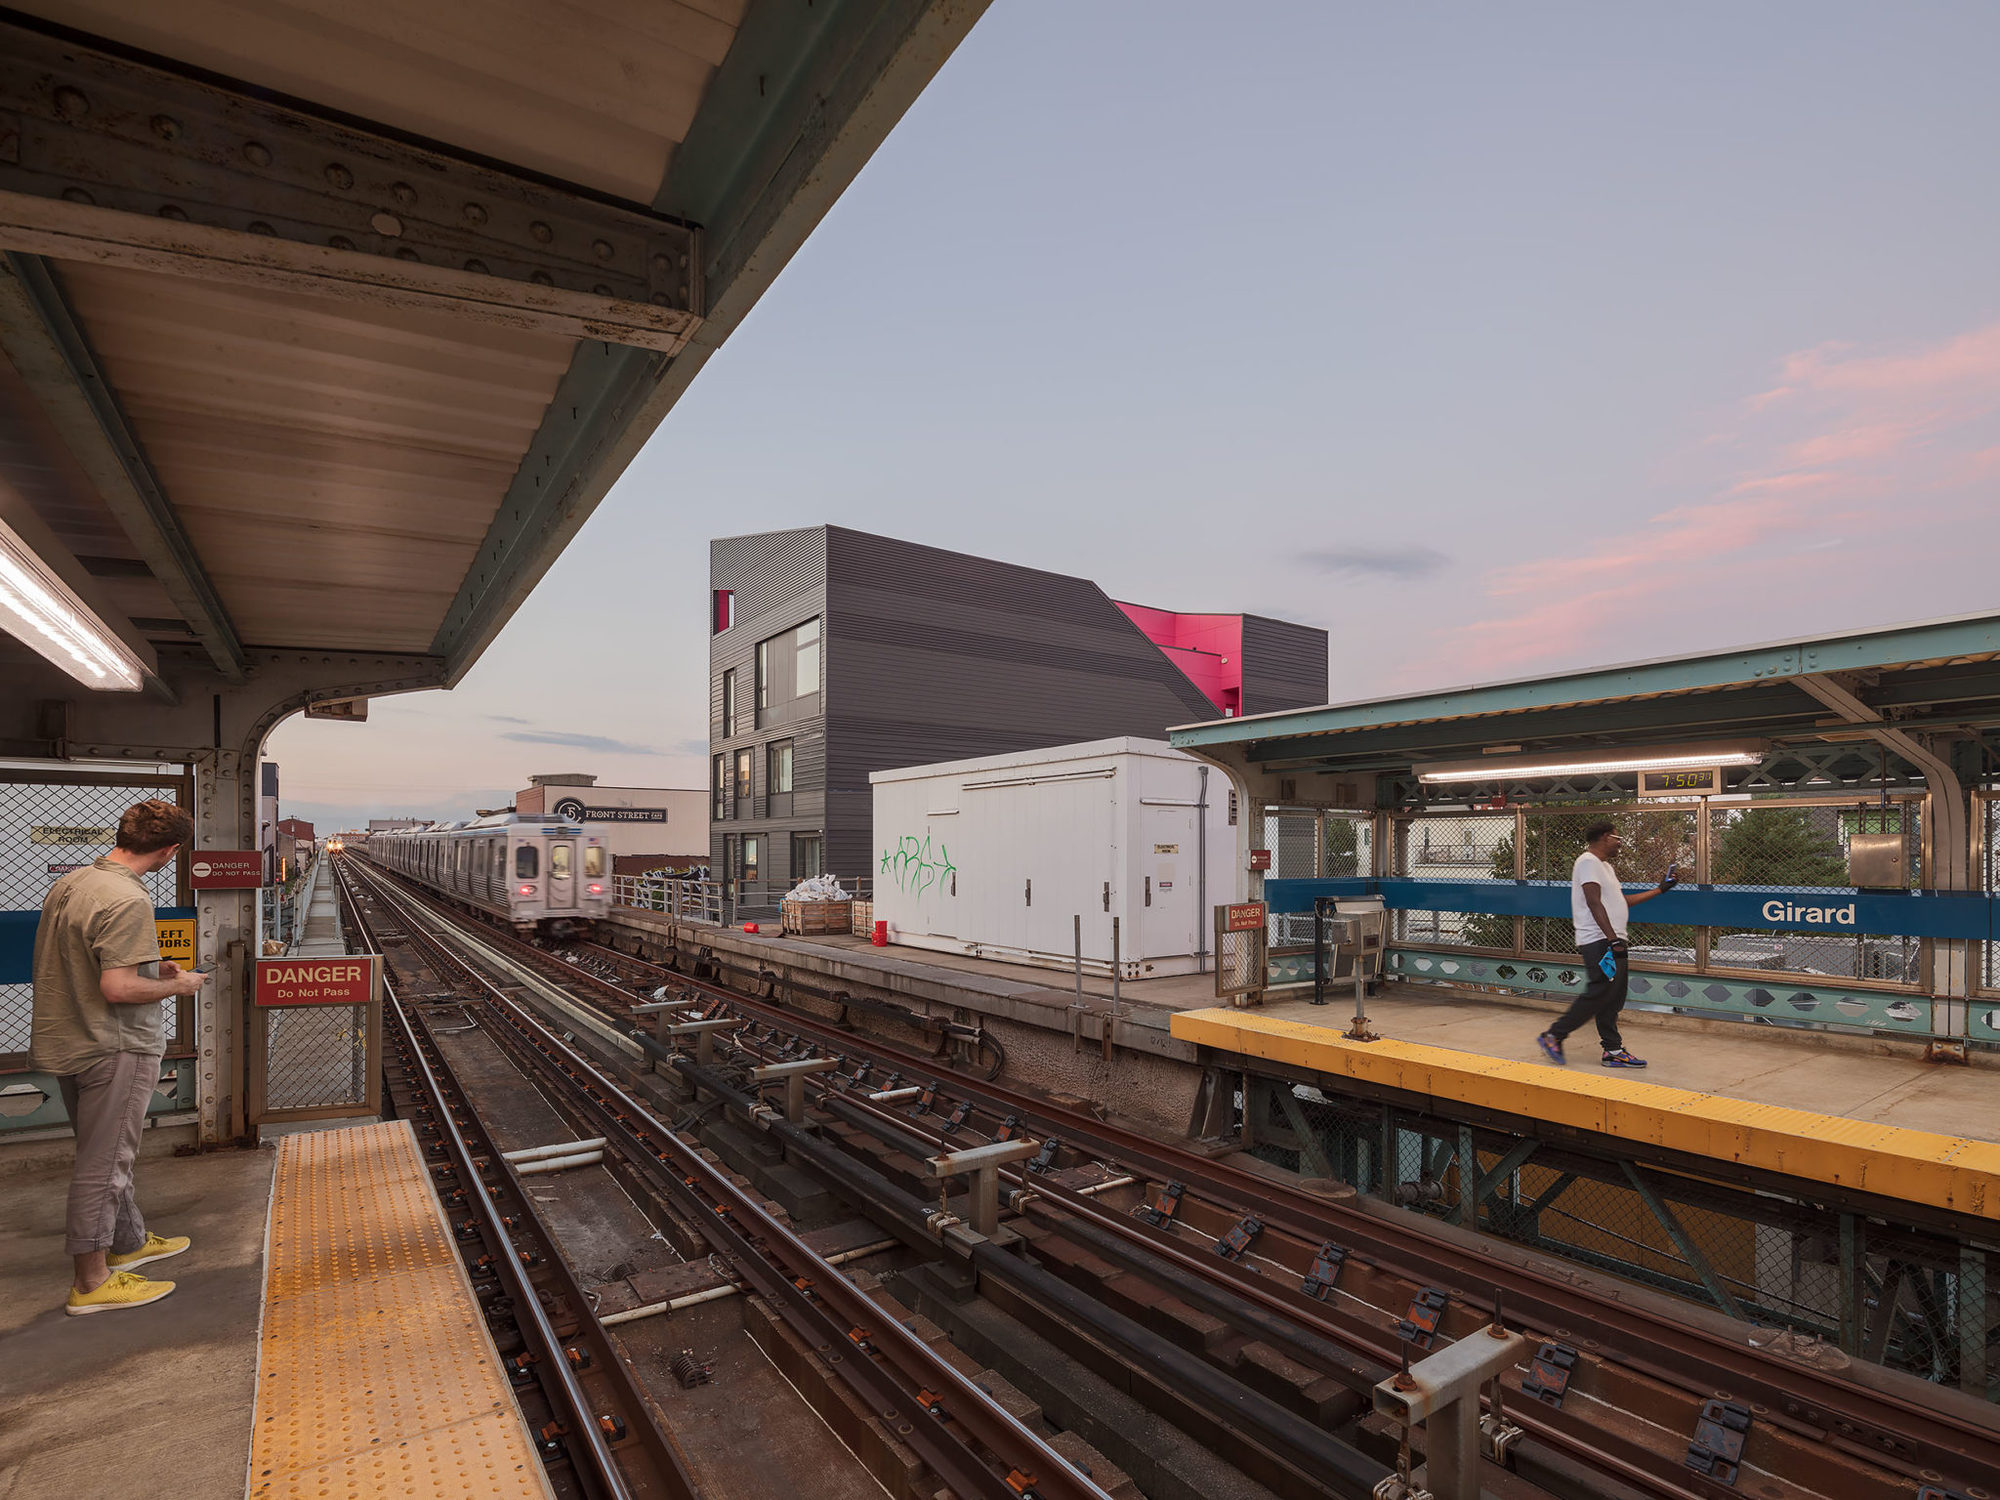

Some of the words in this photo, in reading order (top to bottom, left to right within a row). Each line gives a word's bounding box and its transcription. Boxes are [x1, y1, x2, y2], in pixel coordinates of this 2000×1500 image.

[1661, 774, 1698, 787] 7:50
[585, 810, 615, 819] FRONT
[617, 811, 650, 819] STREET
[42, 827, 103, 835] ELECTRICAL
[58, 836, 88, 844] ROOM
[1231, 908, 1260, 919] DANGER
[1762, 900, 1855, 924] Girard
[157, 929, 185, 938] EFT
[266, 966, 361, 984] DANGER
[277, 989, 294, 998] Do
[298, 988, 319, 997] Not
[323, 987, 350, 996] Pass
